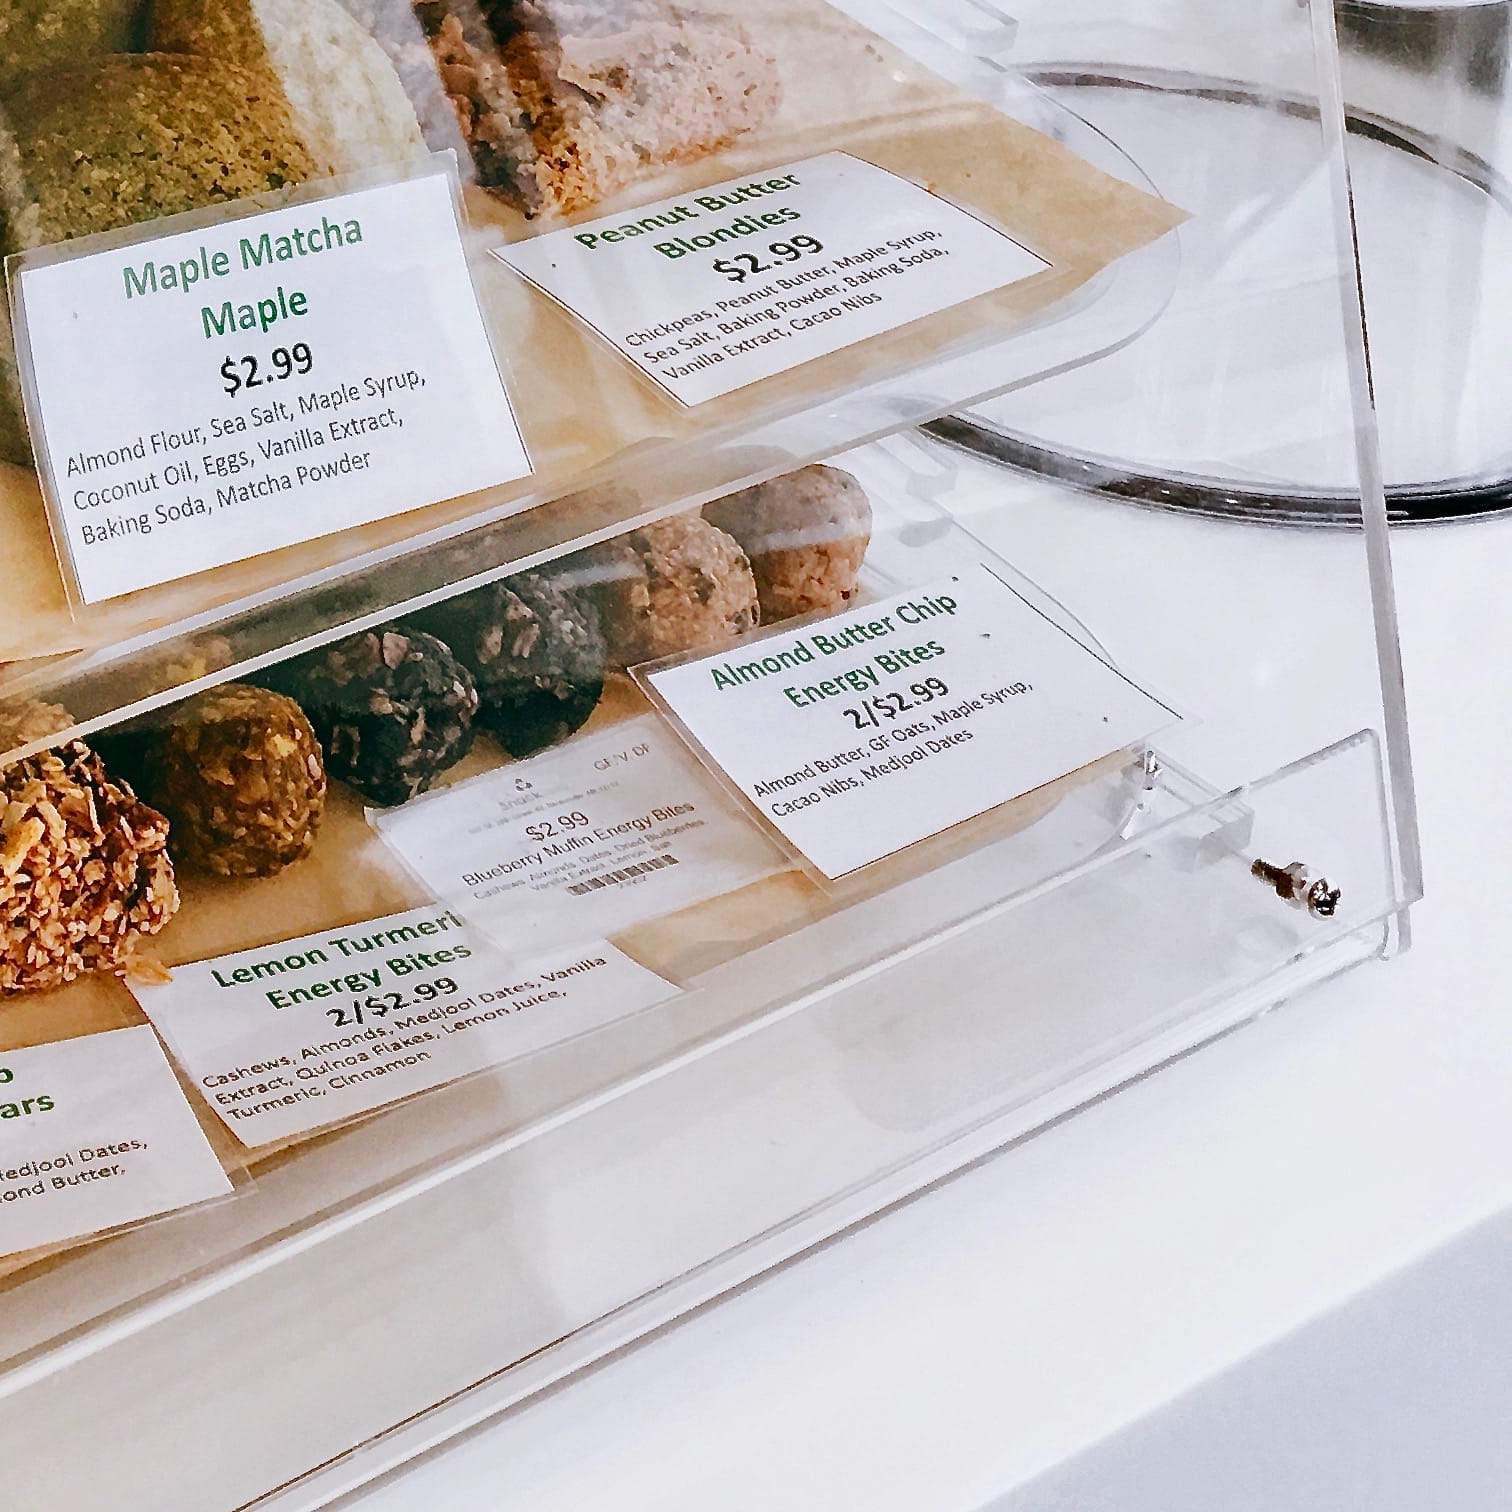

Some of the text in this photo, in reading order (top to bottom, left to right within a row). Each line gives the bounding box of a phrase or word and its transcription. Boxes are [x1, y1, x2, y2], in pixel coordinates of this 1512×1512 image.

[574, 175, 801, 249] Peanut Butter
[653, 206, 802, 259] Blondies
[123, 217, 363, 298] Maple Matcha
[625, 228, 942, 348] Chickpeas, Peanut Maple Syrup,
[713, 235, 824, 283] $2.99
[202, 287, 307, 339] Maple
[644, 258, 904, 365] Sea Salt, Baking Powder, Baking
[662, 292, 882, 383] Vanilla Cacao Nibs
[221, 342, 312, 398] $2.99
[67, 370, 426, 477] Almond Flour, Sea Salt, Maple Syrup,
[73, 409, 402, 511] Coconut Oil, Eggs, Vanilla Extract,
[82, 451, 371, 546] Baking Soda, Matcha Powder
[709, 592, 958, 691] Almond Butter Chip
[784, 637, 946, 710] Energy Bites
[842, 676, 949, 731] 2/$2.99
[752, 764, 814, 798] Almond
[869, 734, 892, 754] GF
[935, 699, 983, 728] Maple
[770, 728, 974, 819] Cacao Dates
[462, 802, 696, 887] Blueberry Muffin Energy Bites
[525, 811, 589, 841] $2.99
[210, 946, 329, 989] Lemon
[265, 941, 472, 1011] Energy Bites
[326, 976, 459, 1028] 2/$2.99
[393, 955, 608, 1030] Medjool Vanilla
[442, 1005, 511, 1035] Lemon
[329, 1050, 431, 1090] Cinnamon
[80, 1139, 148, 1163] Dates,
